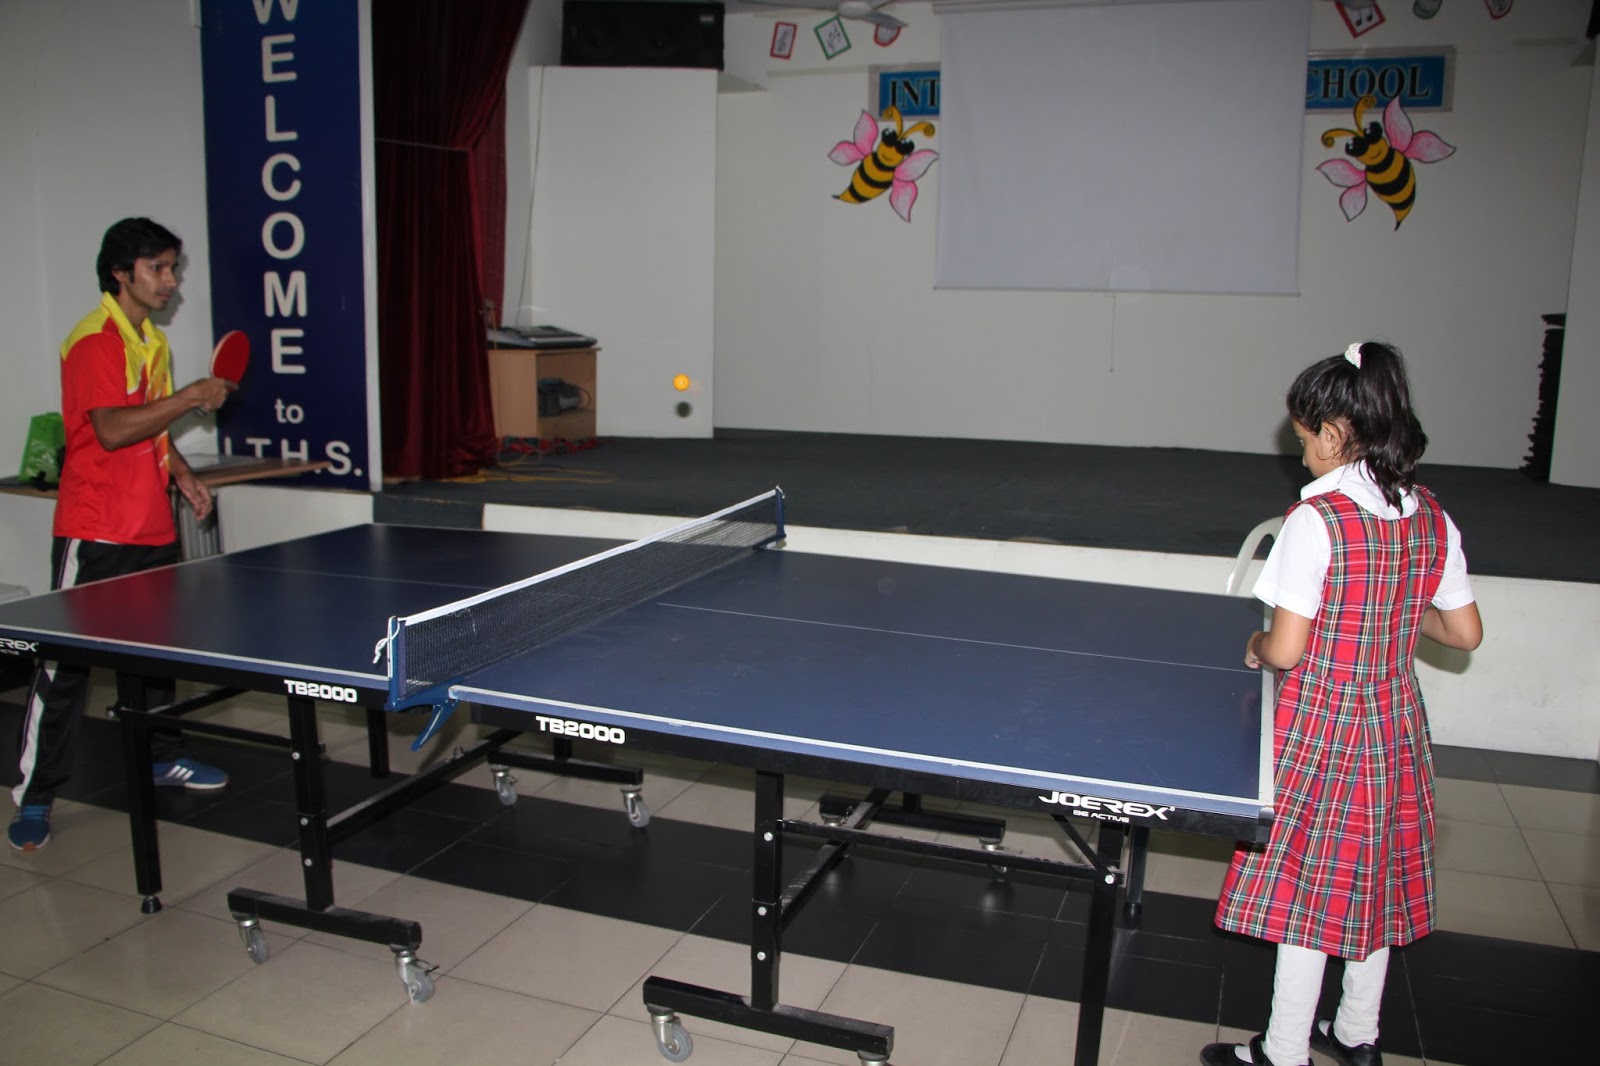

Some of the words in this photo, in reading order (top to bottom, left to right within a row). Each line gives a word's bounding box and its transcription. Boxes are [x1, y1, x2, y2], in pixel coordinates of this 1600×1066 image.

[252, 0, 308, 375] WELCOME
[275, 399, 304, 424] to
[284, 679, 357, 703] TB2000
[535, 715, 626, 744] TB2000
[1038, 791, 1169, 821] JOEREX
